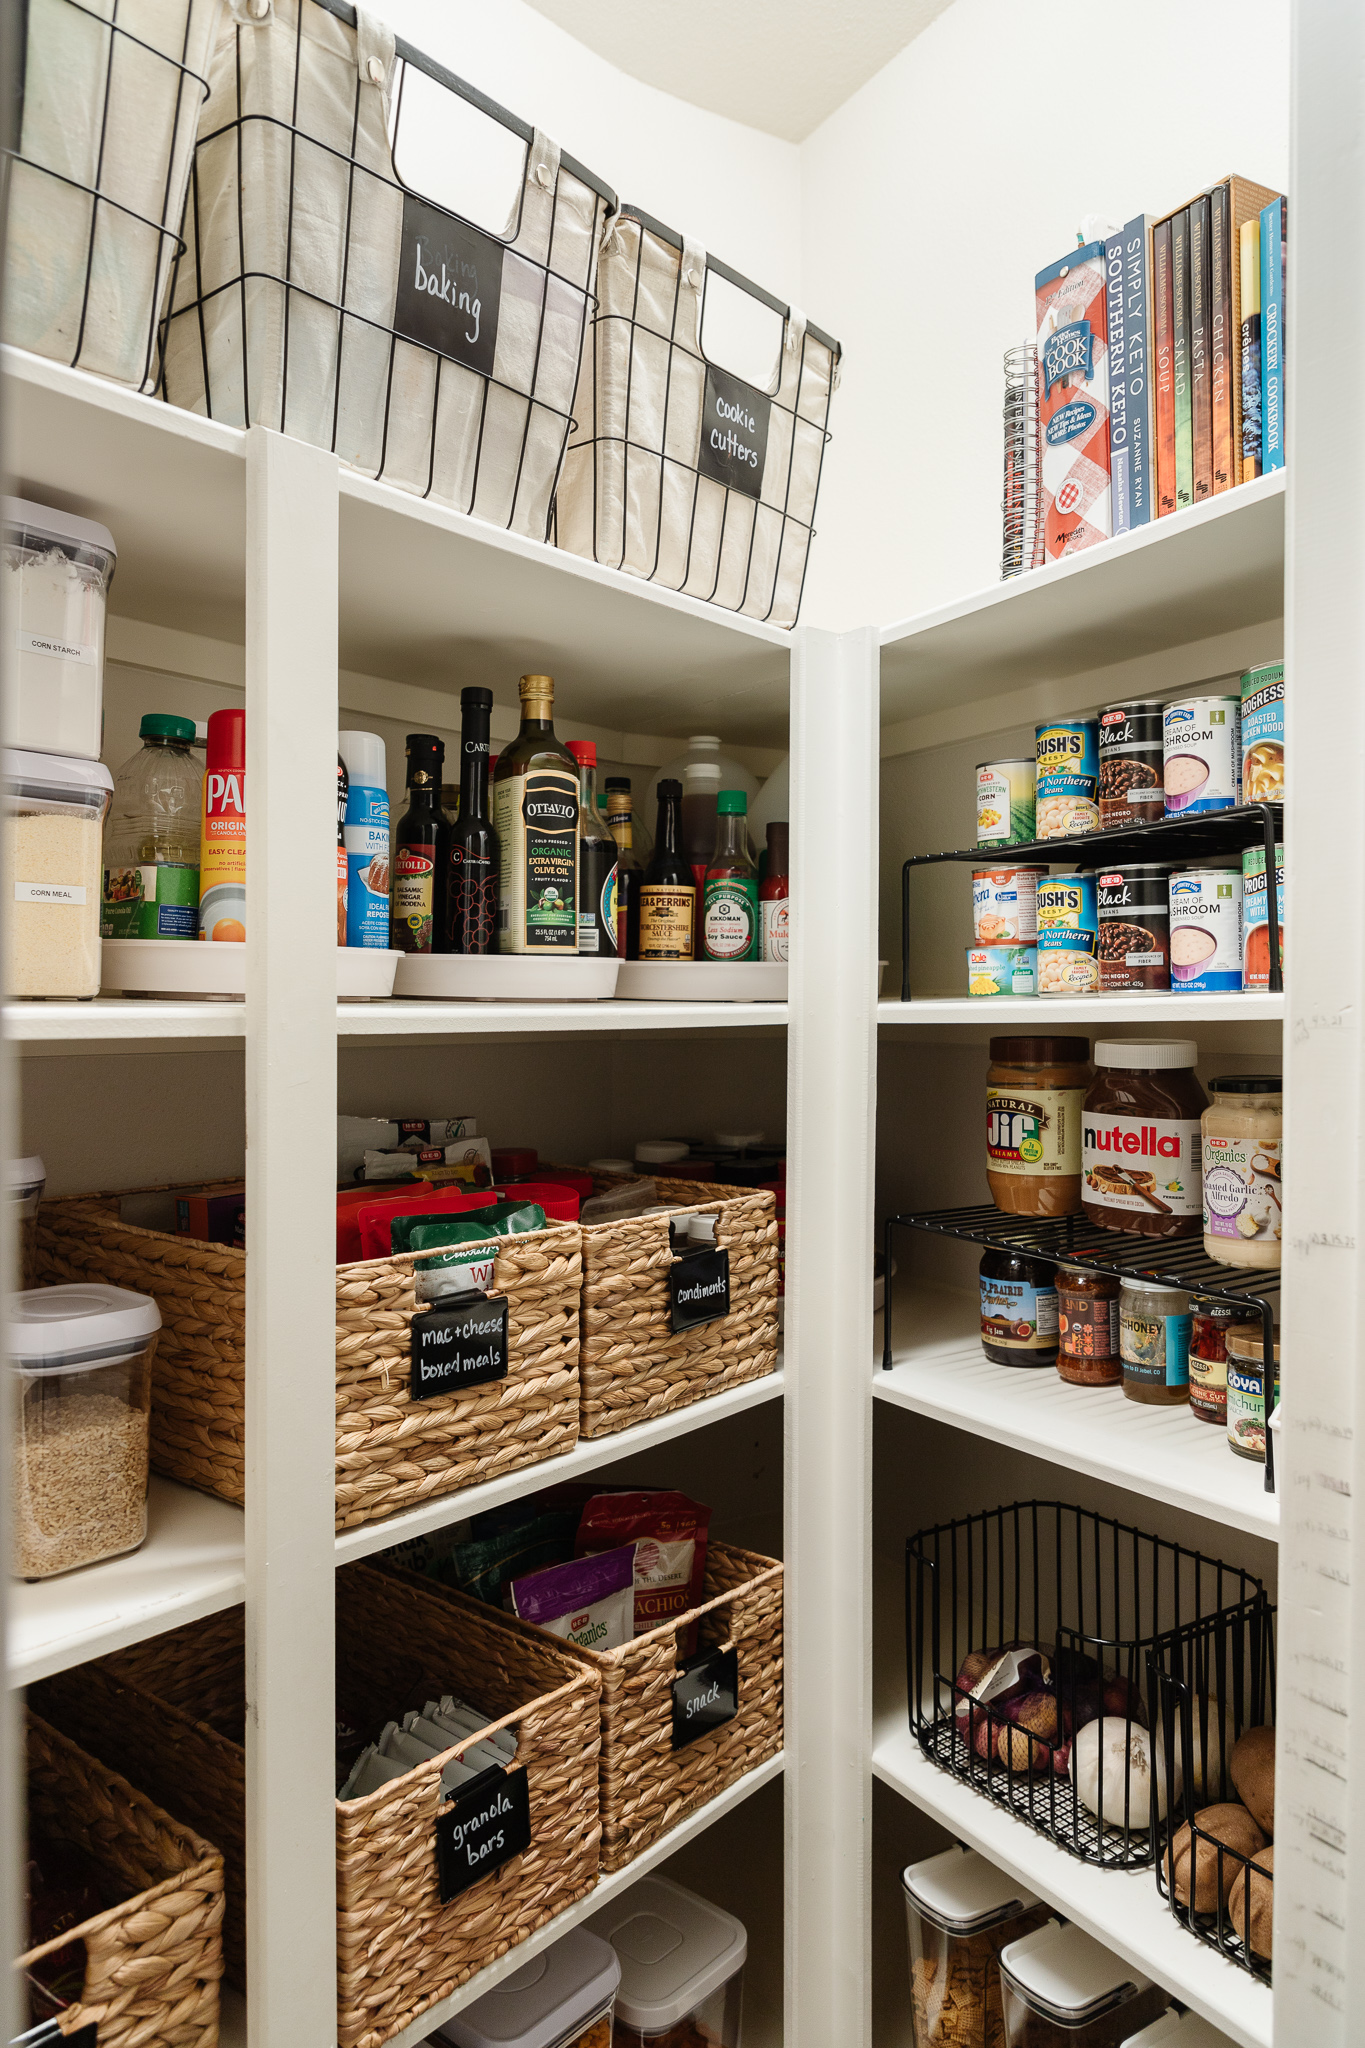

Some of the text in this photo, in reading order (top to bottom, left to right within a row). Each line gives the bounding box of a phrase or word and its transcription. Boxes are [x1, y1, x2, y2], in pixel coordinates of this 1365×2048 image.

[414, 243, 482, 343] baking
[1057, 280, 1085, 299] Edition
[1107, 245, 1125, 377] SOUTHERN
[1127, 237, 1144, 396] SIMPLY KETO
[1046, 336, 1088, 368] COOK
[1193, 326, 1204, 384] PASTA
[1241, 323, 1252, 373] crêpes
[1213, 314, 1224, 403] CHICKEN
[1048, 351, 1087, 382] BOOK
[1158, 346, 1170, 392] SOUP
[1175, 338, 1186, 396] SALAD
[1266, 303, 1279, 454] CROCKERY COOKBOOK
[1065, 405, 1085, 420] Recipes
[1076, 411, 1092, 423] Ideas
[1111, 381, 1127, 444] KETO
[1068, 421, 1086, 435] Photos
[709, 429, 758, 469] cutters
[1133, 417, 1142, 508] SUZANNE RYAN
[1116, 457, 1124, 493] Natasha
[1055, 527, 1085, 544] Meredith
[31, 640, 81, 656] CORN STARCH
[1242, 671, 1284, 689] REDUCED SODIUM
[1241, 683, 1284, 718] PROGRESS
[1247, 712, 1277, 728] ROASTED
[1099, 721, 1134, 747] Black
[1184, 724, 1197, 732] OF
[1262, 721, 1284, 734] NOOD
[1163, 730, 1213, 748] SHROOM
[465, 741, 490, 754] CART
[1036, 735, 1081, 760] BUSH'S
[1104, 746, 1121, 754] BEANS
[1043, 754, 1064, 762] BEST
[1231, 760, 1235, 768] OF
[1046, 776, 1092, 787] Northern
[207, 774, 246, 814] PA
[979, 793, 996, 801] CORN
[1044, 787, 1064, 795] Beans
[527, 803, 575, 819] OTTAVIO
[210, 821, 246, 831] ORIGIN
[1069, 820, 1094, 828] Recipes
[365, 842, 384, 850] WITH
[531, 847, 572, 858] ORGANIC
[528, 857, 575, 867] EXTRA VIRGIN
[533, 866, 569, 875] OLIVE OIL
[30, 889, 72, 898] CORN MEAL
[1097, 885, 1132, 906] Black
[368, 902, 386, 911] IDEAL
[656, 897, 691, 908] PERRINS
[1245, 895, 1267, 908] CREAMY
[1170, 904, 1221, 917] SHROOM
[1249, 905, 1266, 917] WITH
[1045, 929, 1090, 941] Northern
[1238, 934, 1243, 942] OF
[971, 953, 987, 962] Dole
[977, 964, 1006, 972] pineapple
[1068, 973, 1093, 983] Recipes
[987, 1099, 1035, 1113] NATURAL
[987, 1113, 1035, 1148] Jif
[1084, 1125, 1180, 1158] nutella
[991, 1150, 1018, 1158] CREAMY
[1204, 1144, 1247, 1165] Organics
[1229, 1182, 1258, 1195] Garlic
[1210, 1191, 1239, 1203] Alfredo
[676, 1275, 727, 1304] condiments
[989, 1283, 1024, 1297] PRAIRIE
[1210, 1308, 1232, 1317] ALESSI
[422, 1316, 503, 1347] mac cheese
[993, 1327, 1004, 1336] Jam
[1127, 1320, 1163, 1334] HONEY
[420, 1345, 501, 1381] boxed meals
[1227, 1372, 1261, 1394] GOYA
[657, 1572, 682, 1582] DESERT
[634, 1622, 655, 1630] CHILE
[566, 1621, 608, 1648] Organics
[451, 1793, 513, 1851] granola
[466, 1826, 506, 1866] bars
